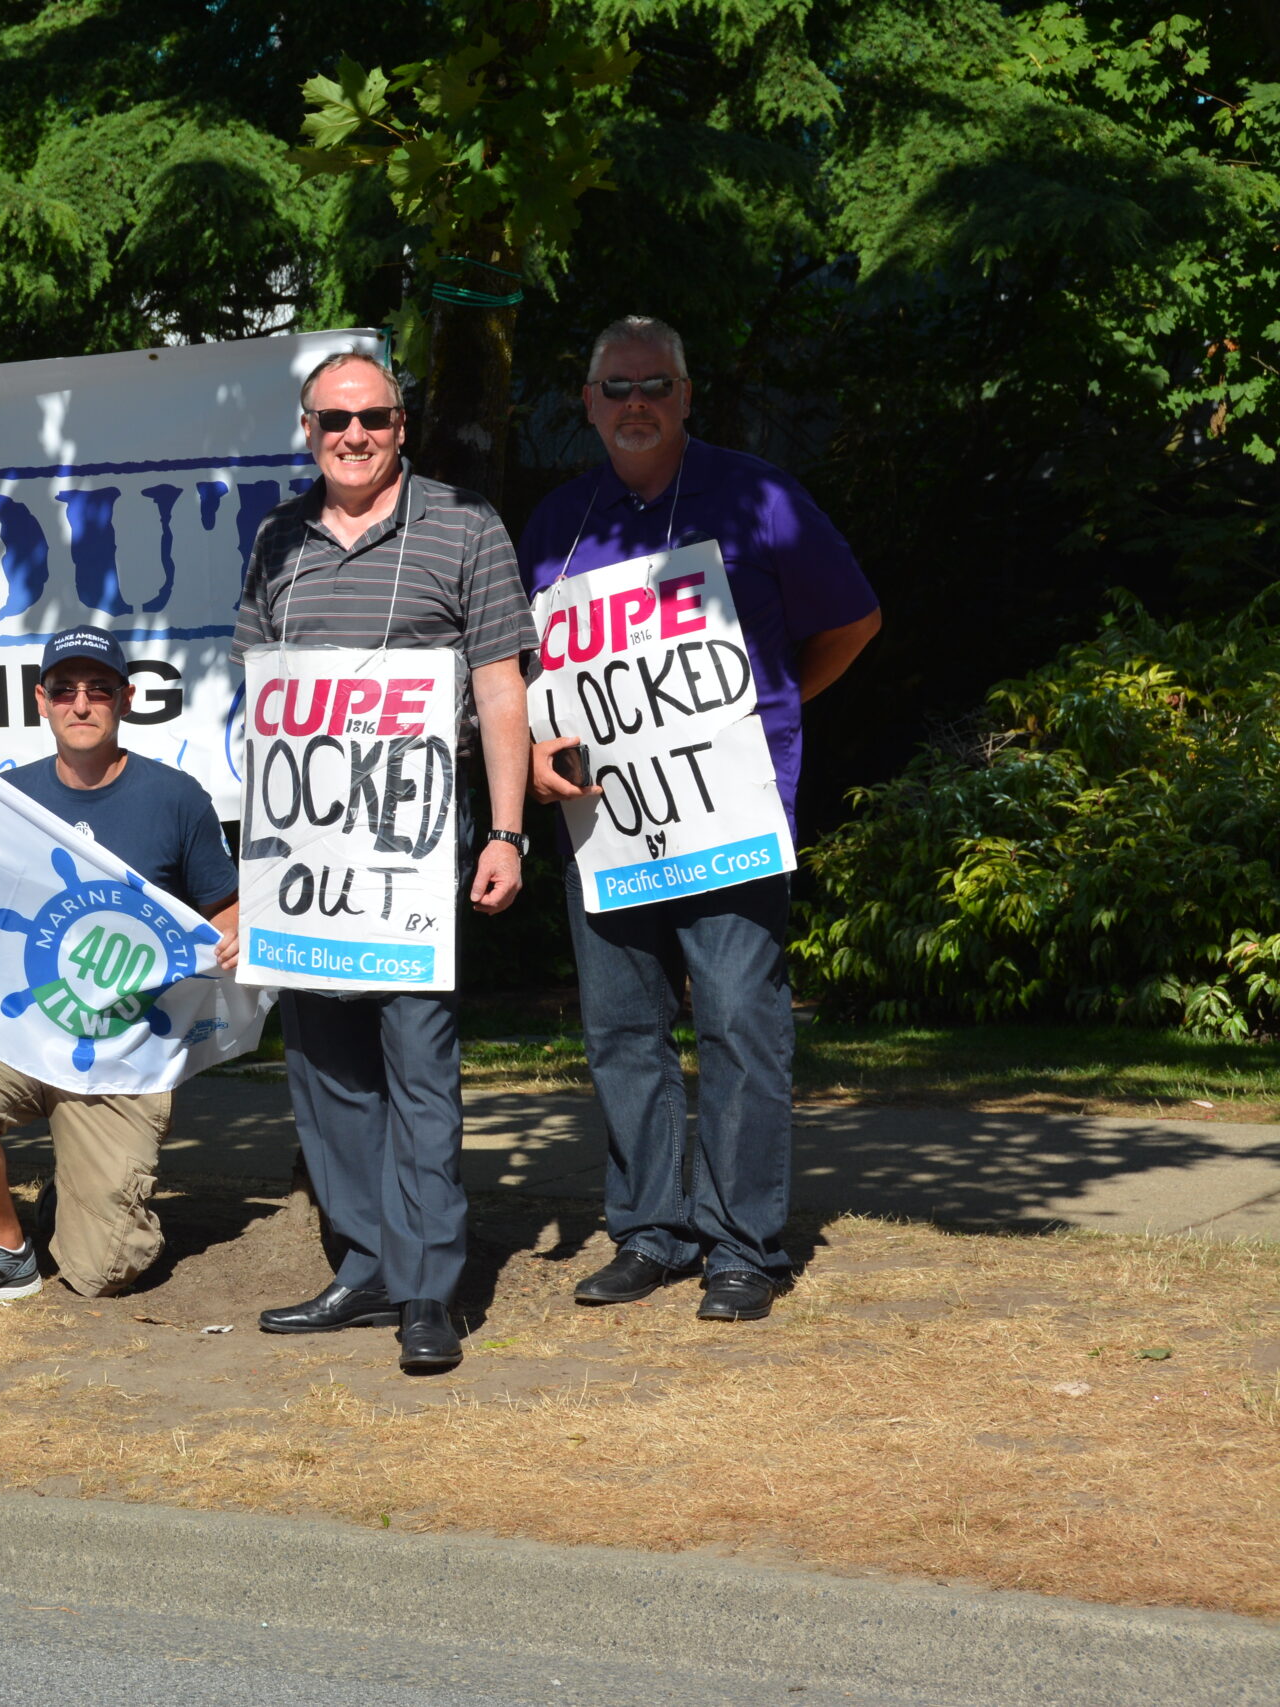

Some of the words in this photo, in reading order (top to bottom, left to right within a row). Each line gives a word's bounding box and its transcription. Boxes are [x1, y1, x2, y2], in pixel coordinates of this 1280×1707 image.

[54, 633, 74, 646] MAKE
[75, 632, 110, 646] AMERICA
[55, 639, 82, 652] UNION
[82, 640, 108, 652] AGAIN
[540, 570, 708, 671] CUPE
[628, 628, 653, 646] 1816
[254, 677, 435, 737] CUPE
[345, 718, 376, 735] 1816
[241, 734, 454, 861] LOCKED
[594, 741, 716, 837] OUT
[646, 830, 667, 860] BY
[278, 862, 419, 921] OUT
[605, 869, 663, 898] Pacific
[663, 859, 708, 887] Blue
[711, 846, 771, 876] Cross
[35, 889, 123, 950] MARINE
[67, 924, 156, 997] 400
[257, 938, 307, 968] Pacific
[311, 946, 354, 972] Blue
[358, 952, 425, 977] Cross
[43, 987, 142, 1037] ILWU
